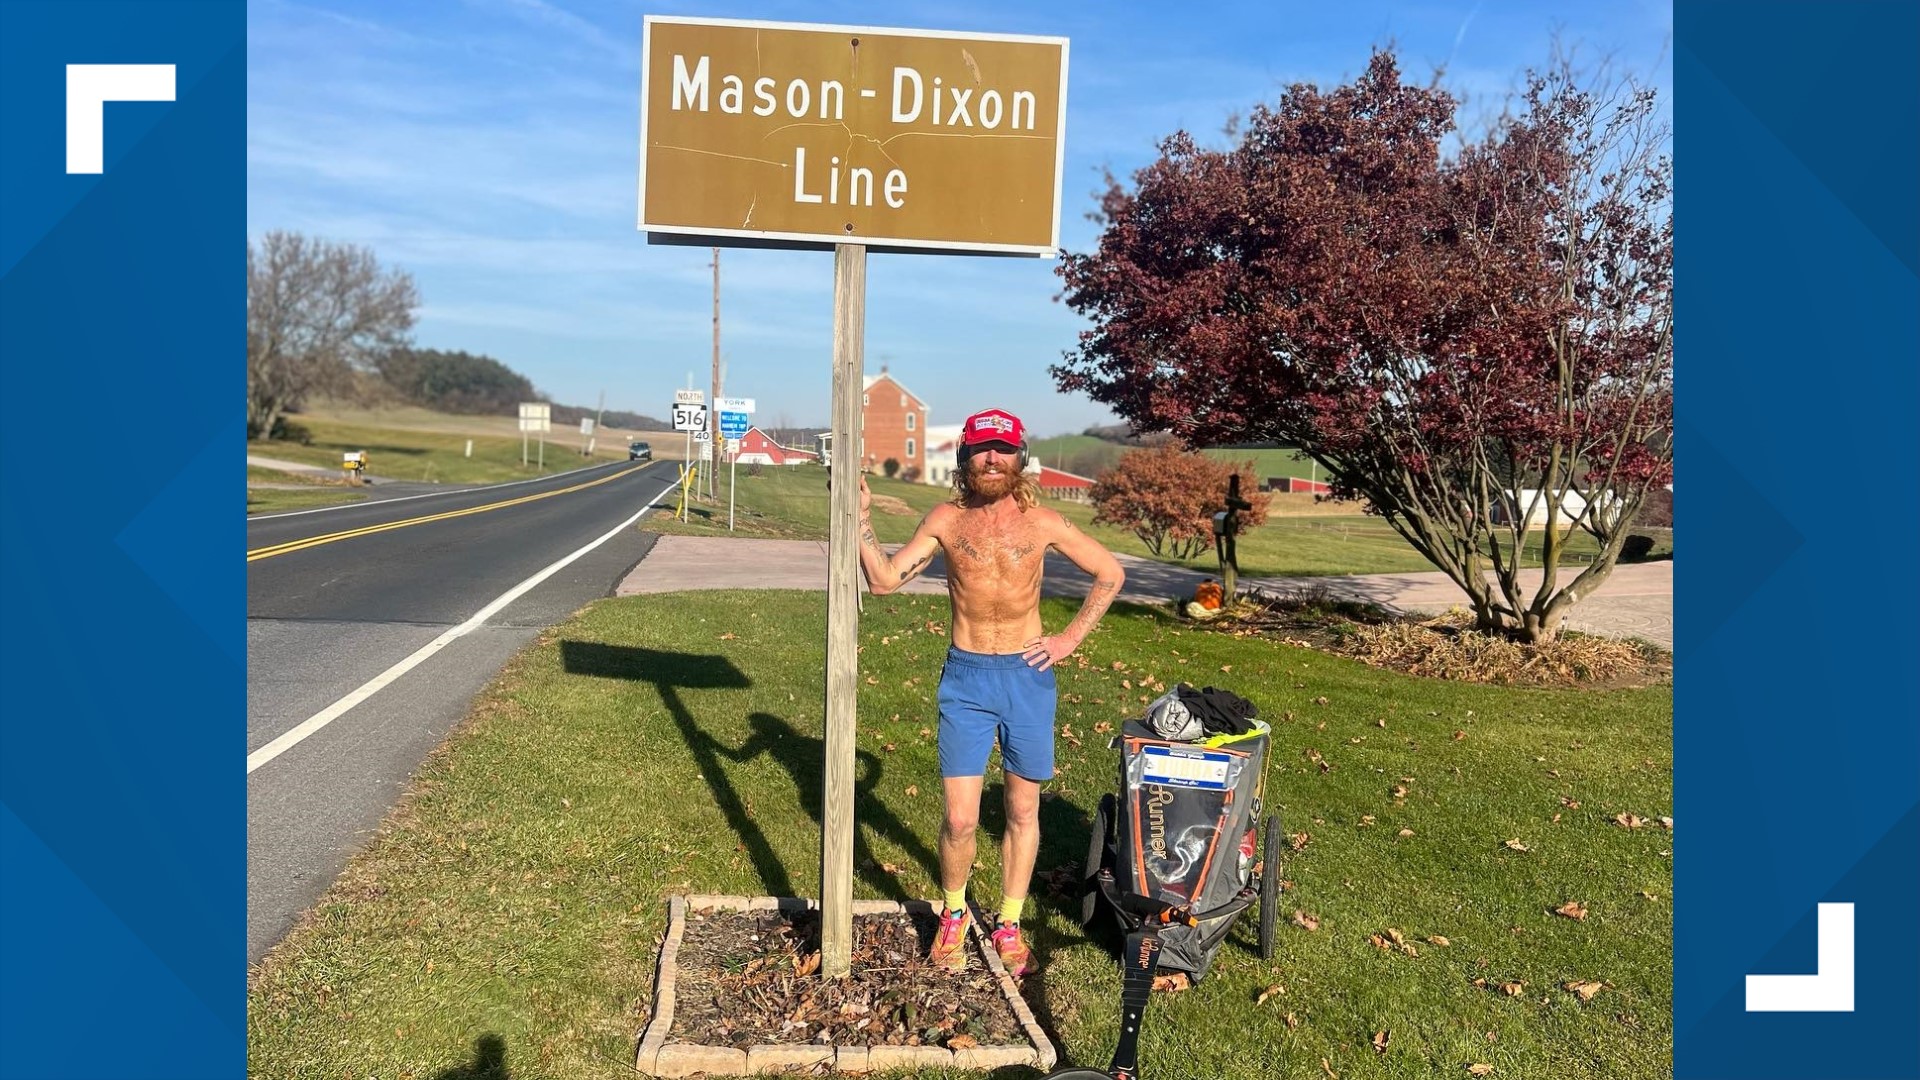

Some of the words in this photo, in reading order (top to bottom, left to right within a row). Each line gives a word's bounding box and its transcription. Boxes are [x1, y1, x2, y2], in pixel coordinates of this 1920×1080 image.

[794, 147, 908, 209] Line
[677, 392, 703, 401] NORTH
[676, 410, 703, 426] 516
[695, 431, 710, 440] 40
